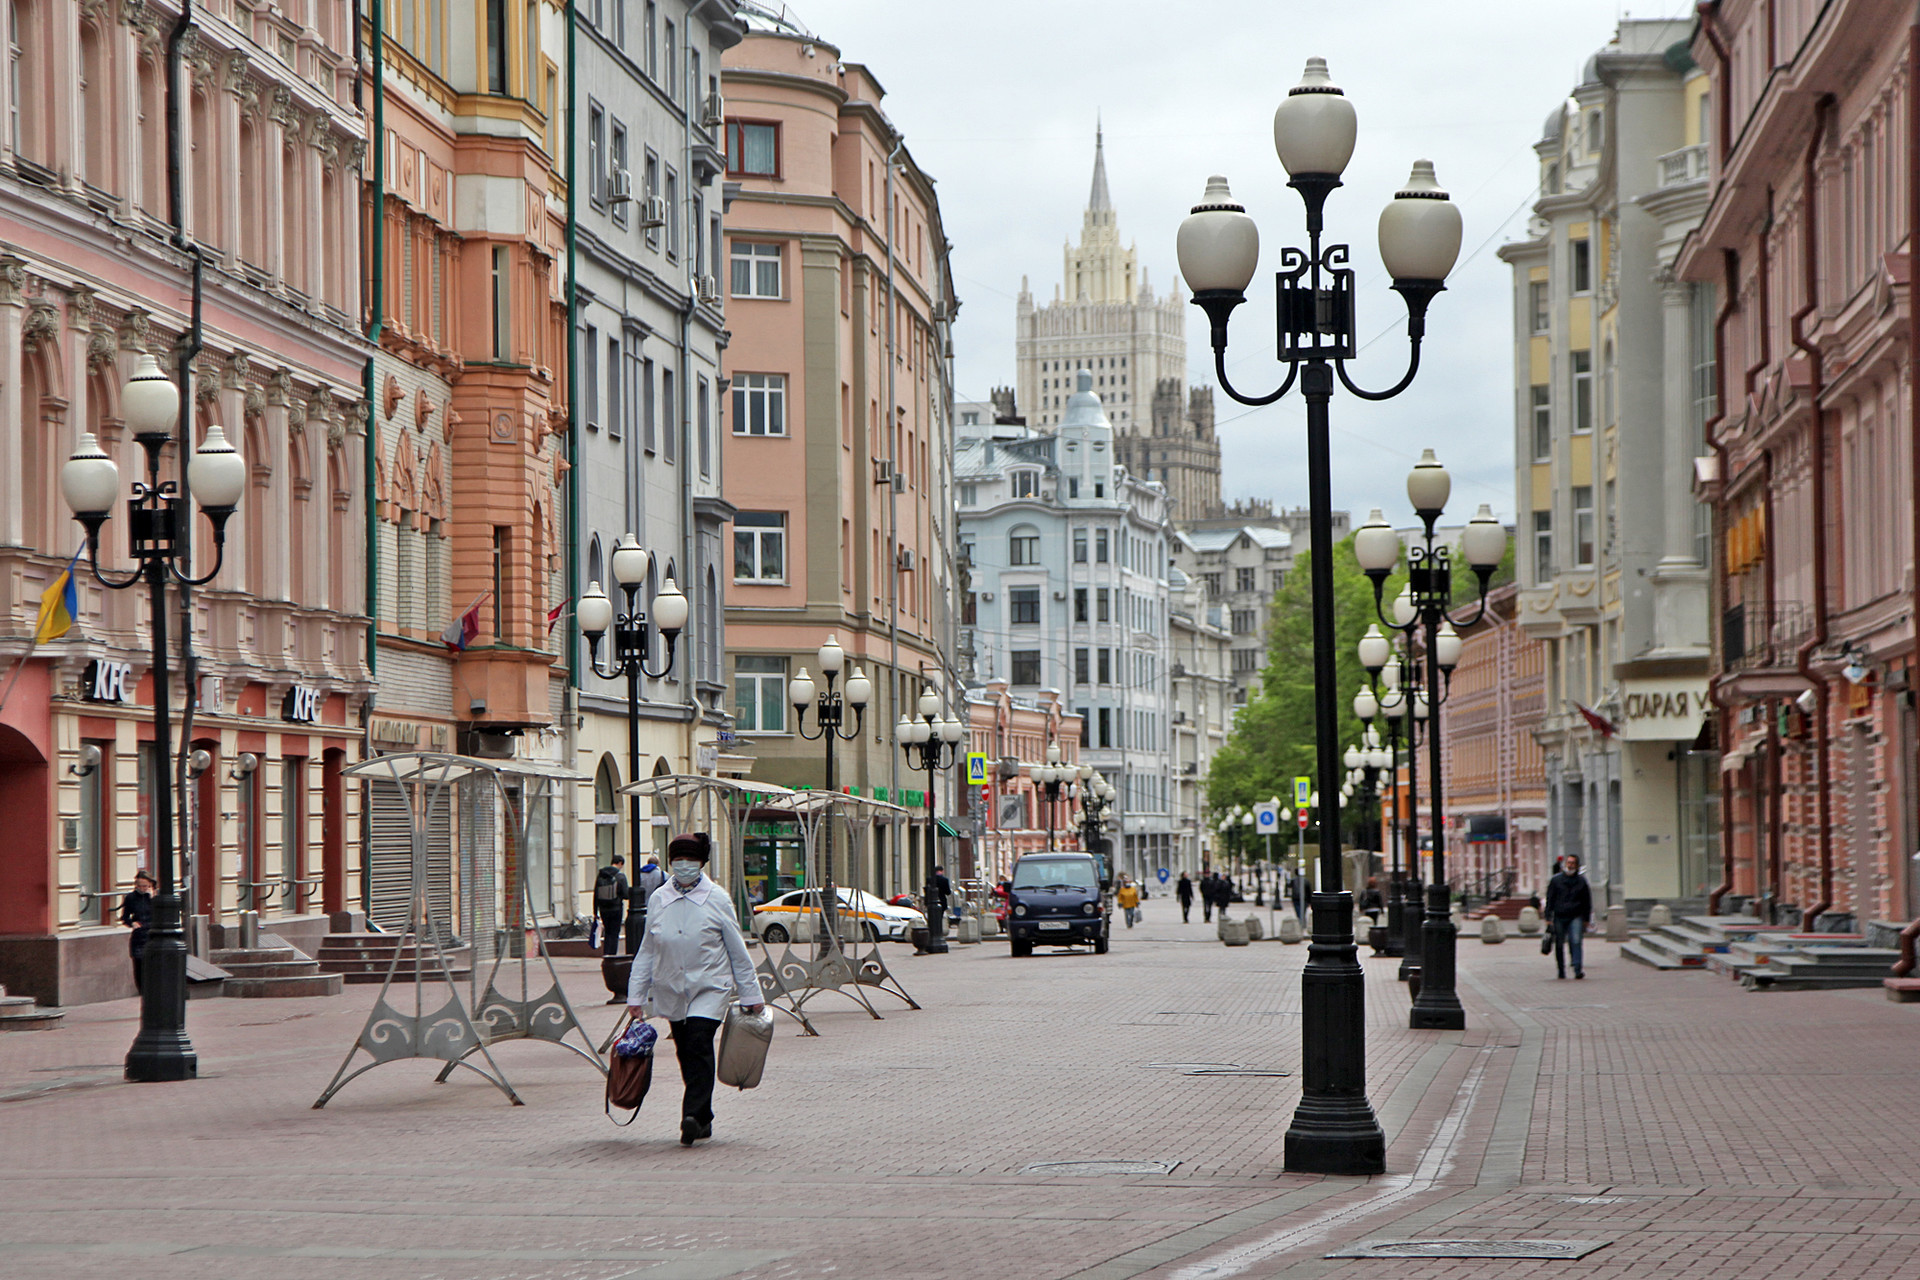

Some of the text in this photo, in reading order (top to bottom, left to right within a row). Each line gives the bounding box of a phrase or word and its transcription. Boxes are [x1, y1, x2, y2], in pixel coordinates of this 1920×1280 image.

[93, 659, 131, 703] KFC
[292, 685, 321, 722] KFC
[1625, 690, 1689, 719] СТАРАЯ
